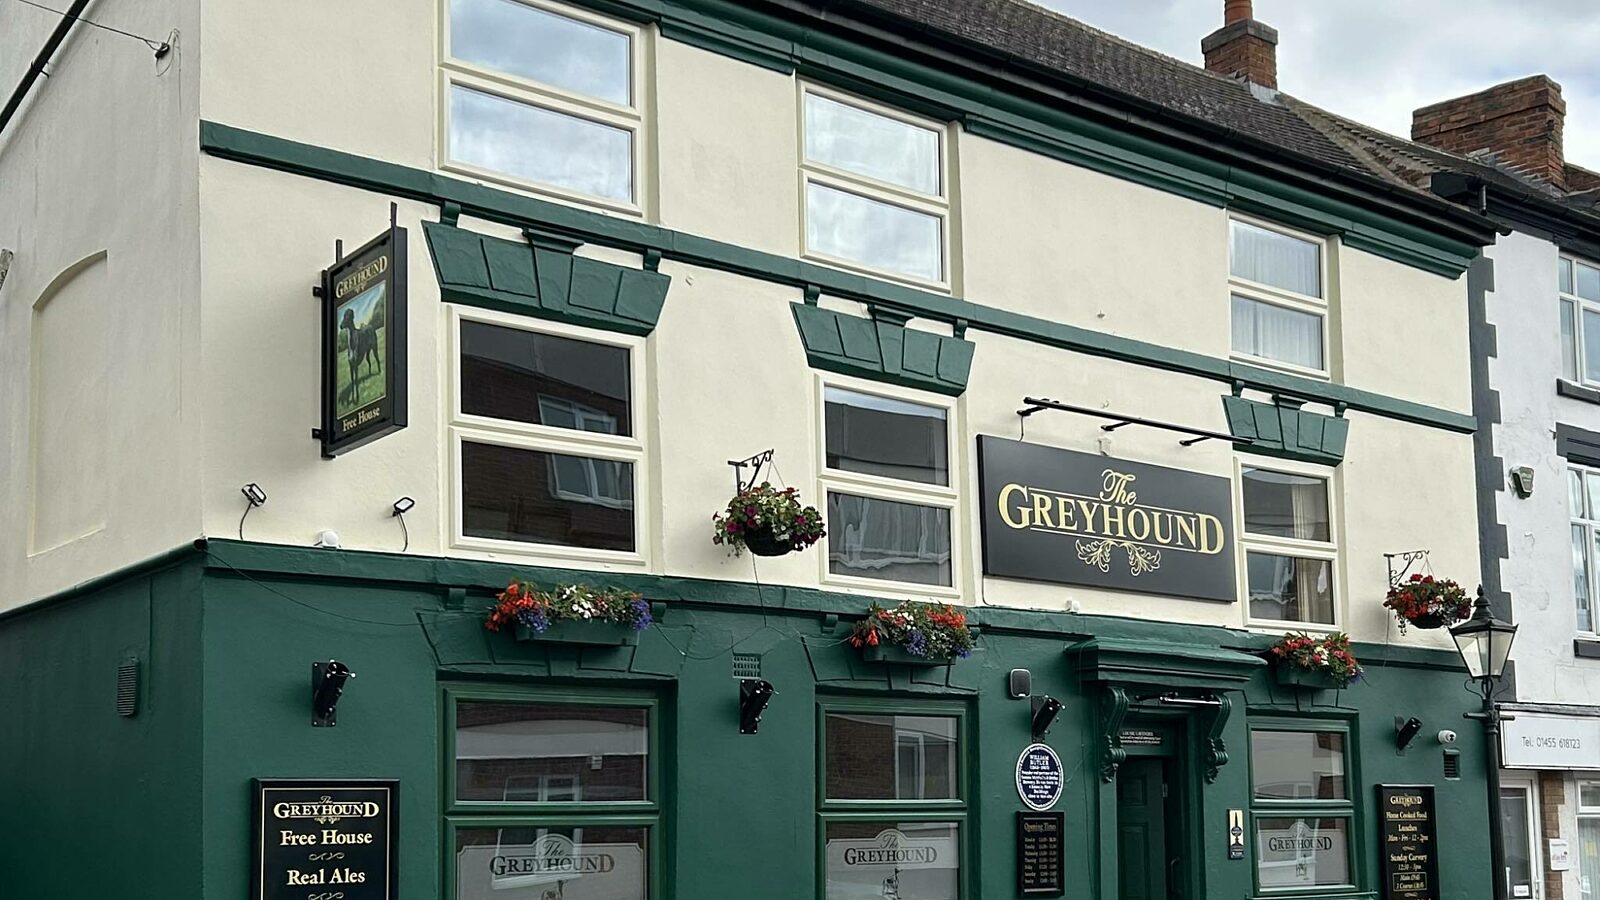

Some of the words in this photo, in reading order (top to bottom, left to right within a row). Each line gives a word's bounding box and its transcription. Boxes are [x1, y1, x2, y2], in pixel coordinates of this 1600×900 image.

[336, 255, 388, 298] GREYHOUND
[343, 419, 357, 431] Free
[358, 407, 380, 424] House
[1100, 469, 1137, 505] The
[998, 483, 1225, 555] GREYHOUND
[1536, 737, 1556, 748] 01455
[1559, 738, 1581, 749] 618123
[319, 795, 333, 804] The
[273, 802, 380, 818] GREYHOUND
[1024, 822, 1043, 832] Opening
[280, 830, 317, 845] Free
[320, 829, 373, 845] House
[880, 834, 898, 849] The
[1269, 837, 1332, 851] GREYHOUND
[538, 840, 564, 857] The
[844, 847, 937, 865] GREYHOUND
[490, 854, 615, 875] GREYHOUND
[1390, 853, 1407, 863] Sunday
[1408, 853, 1427, 863] Carvery
[286, 868, 325, 885] Real
[329, 867, 366, 884] Ales
